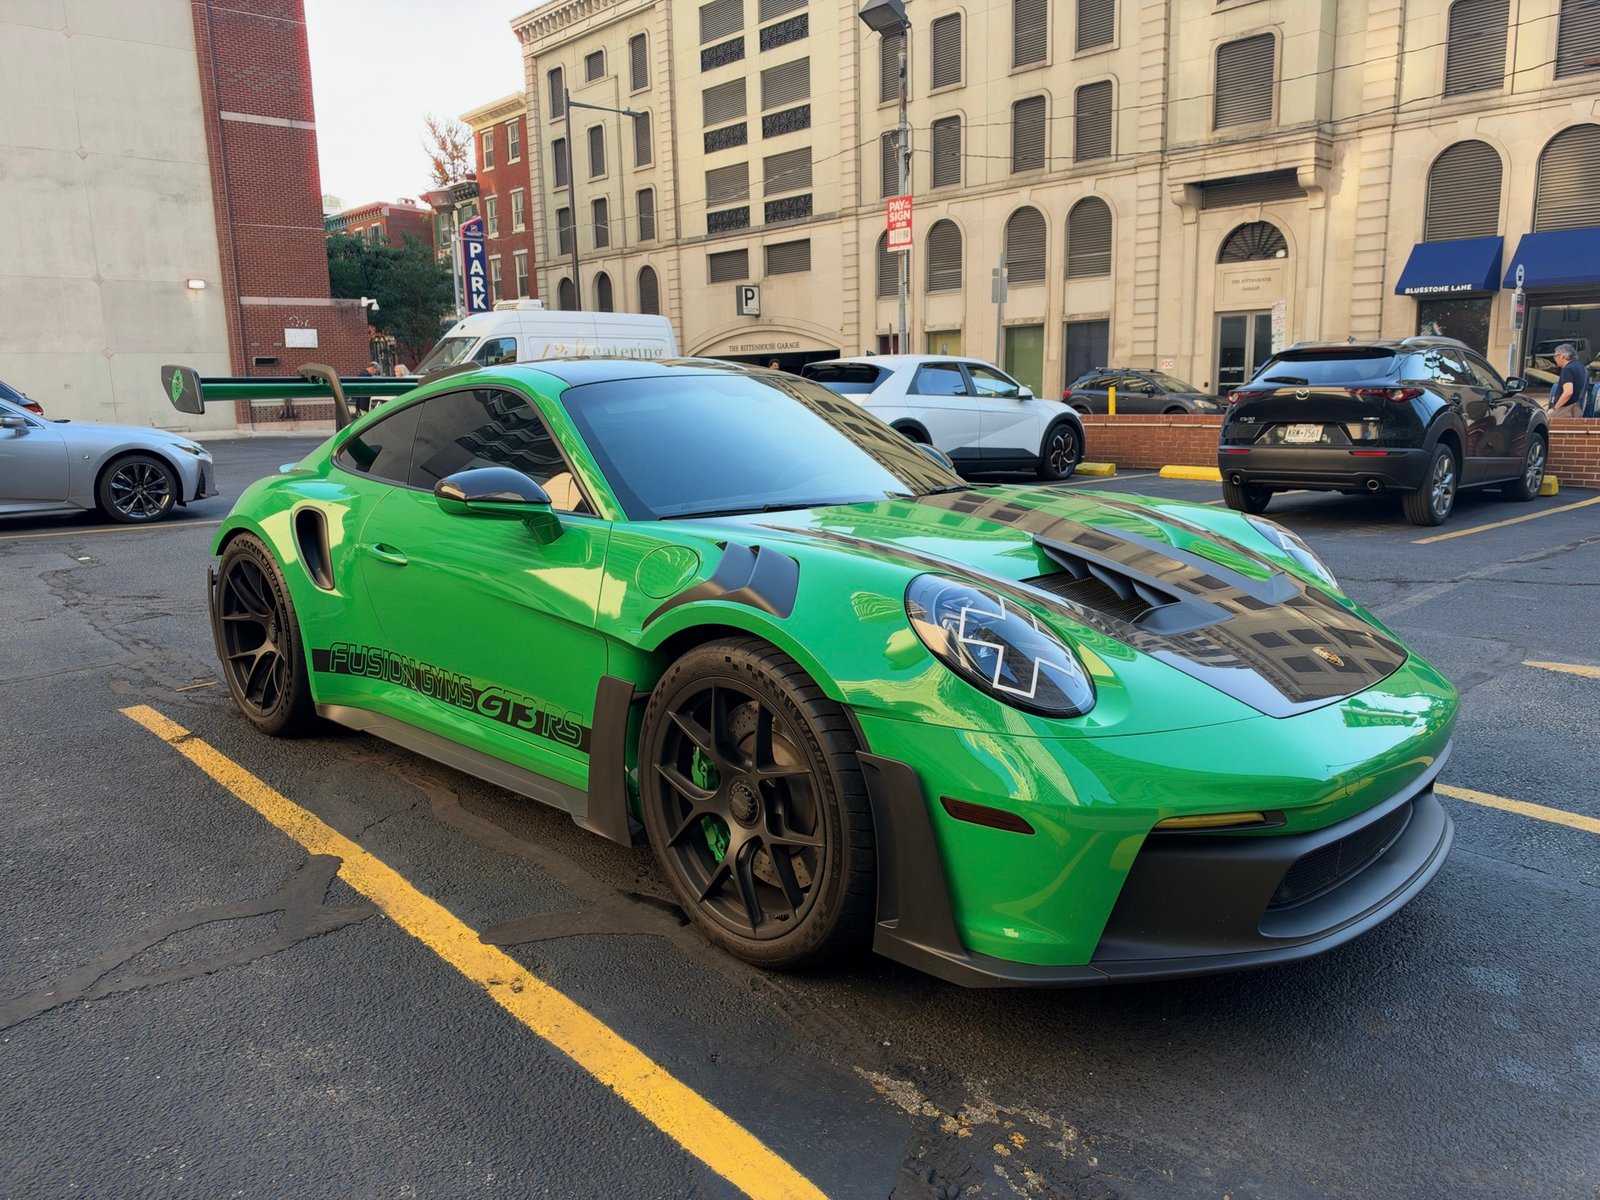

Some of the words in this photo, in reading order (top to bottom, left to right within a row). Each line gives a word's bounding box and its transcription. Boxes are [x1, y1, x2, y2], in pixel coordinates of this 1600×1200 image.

[889, 200, 905, 212] PAY
[889, 210, 911, 222] SIGN
[469, 242, 486, 309] PARK
[1405, 285, 1449, 294] BLUESTONE
[1451, 284, 1472, 292] LANE
[744, 288, 755, 307] P
[740, 343, 776, 352] RITTENHOUSE
[777, 341, 800, 350] GARAGE
[329, 641, 416, 689] FUSION
[420, 662, 475, 710] GYMS
[477, 686, 539, 729] GT3
[541, 702, 584, 748] RS
[797, 718, 837, 805] MICHELIN
